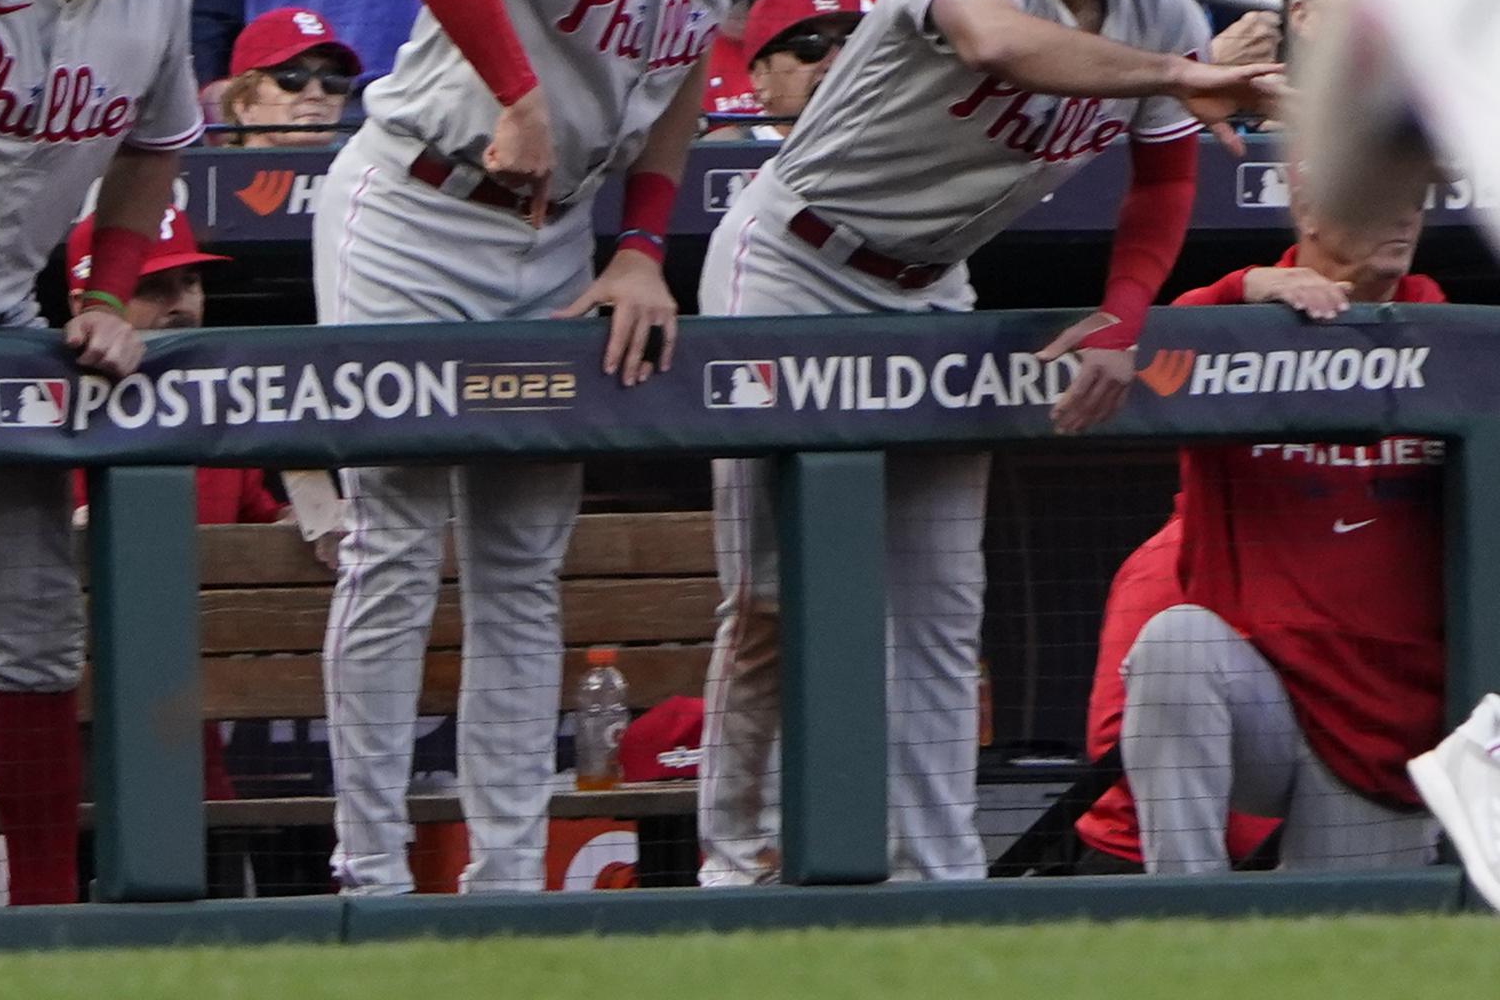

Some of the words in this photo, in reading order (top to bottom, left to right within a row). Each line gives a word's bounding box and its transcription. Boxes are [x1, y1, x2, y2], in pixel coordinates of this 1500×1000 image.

[73, 360, 463, 431] POSTSEASON
[463, 373, 577, 401] 2022
[779, 355, 926, 411] WILD
